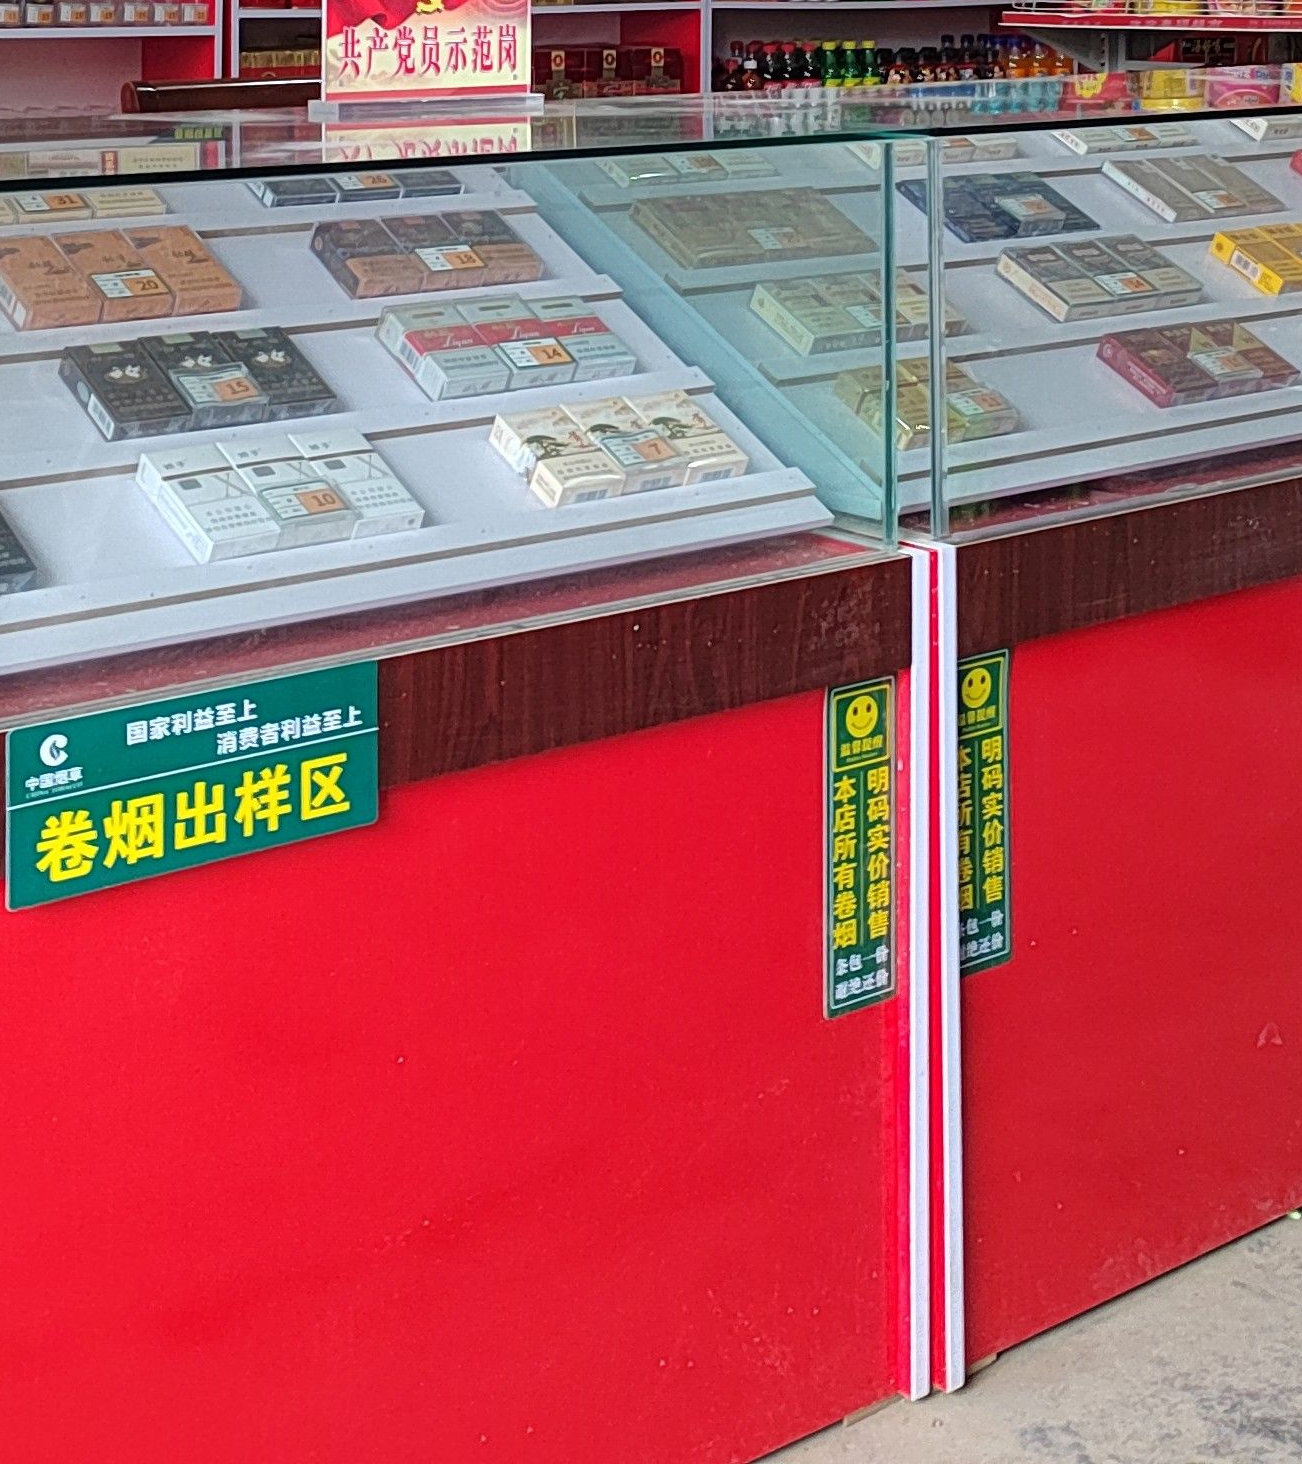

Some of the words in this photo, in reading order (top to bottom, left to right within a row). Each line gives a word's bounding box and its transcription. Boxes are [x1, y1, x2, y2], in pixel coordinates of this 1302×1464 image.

[337, 24, 518, 81] 共产党员示范岗
[56, 194, 79, 206] 31
[456, 252, 475, 265] 18
[137, 277, 159, 292] 20
[541, 347, 563, 361] 14
[227, 380, 250, 395] 15
[313, 492, 337, 507] 10
[126, 698, 258, 746] 国家利益至上
[216, 705, 363, 756] 消费者利益至上
[25, 766, 84, 791] 中国烟草
[35, 752, 351, 884] 卷烟出样区
[980, 734, 1005, 904] 明码实价销售
[832, 774, 858, 951] 本店所有卷烟
[866, 765, 891, 940] 明码实价销售
